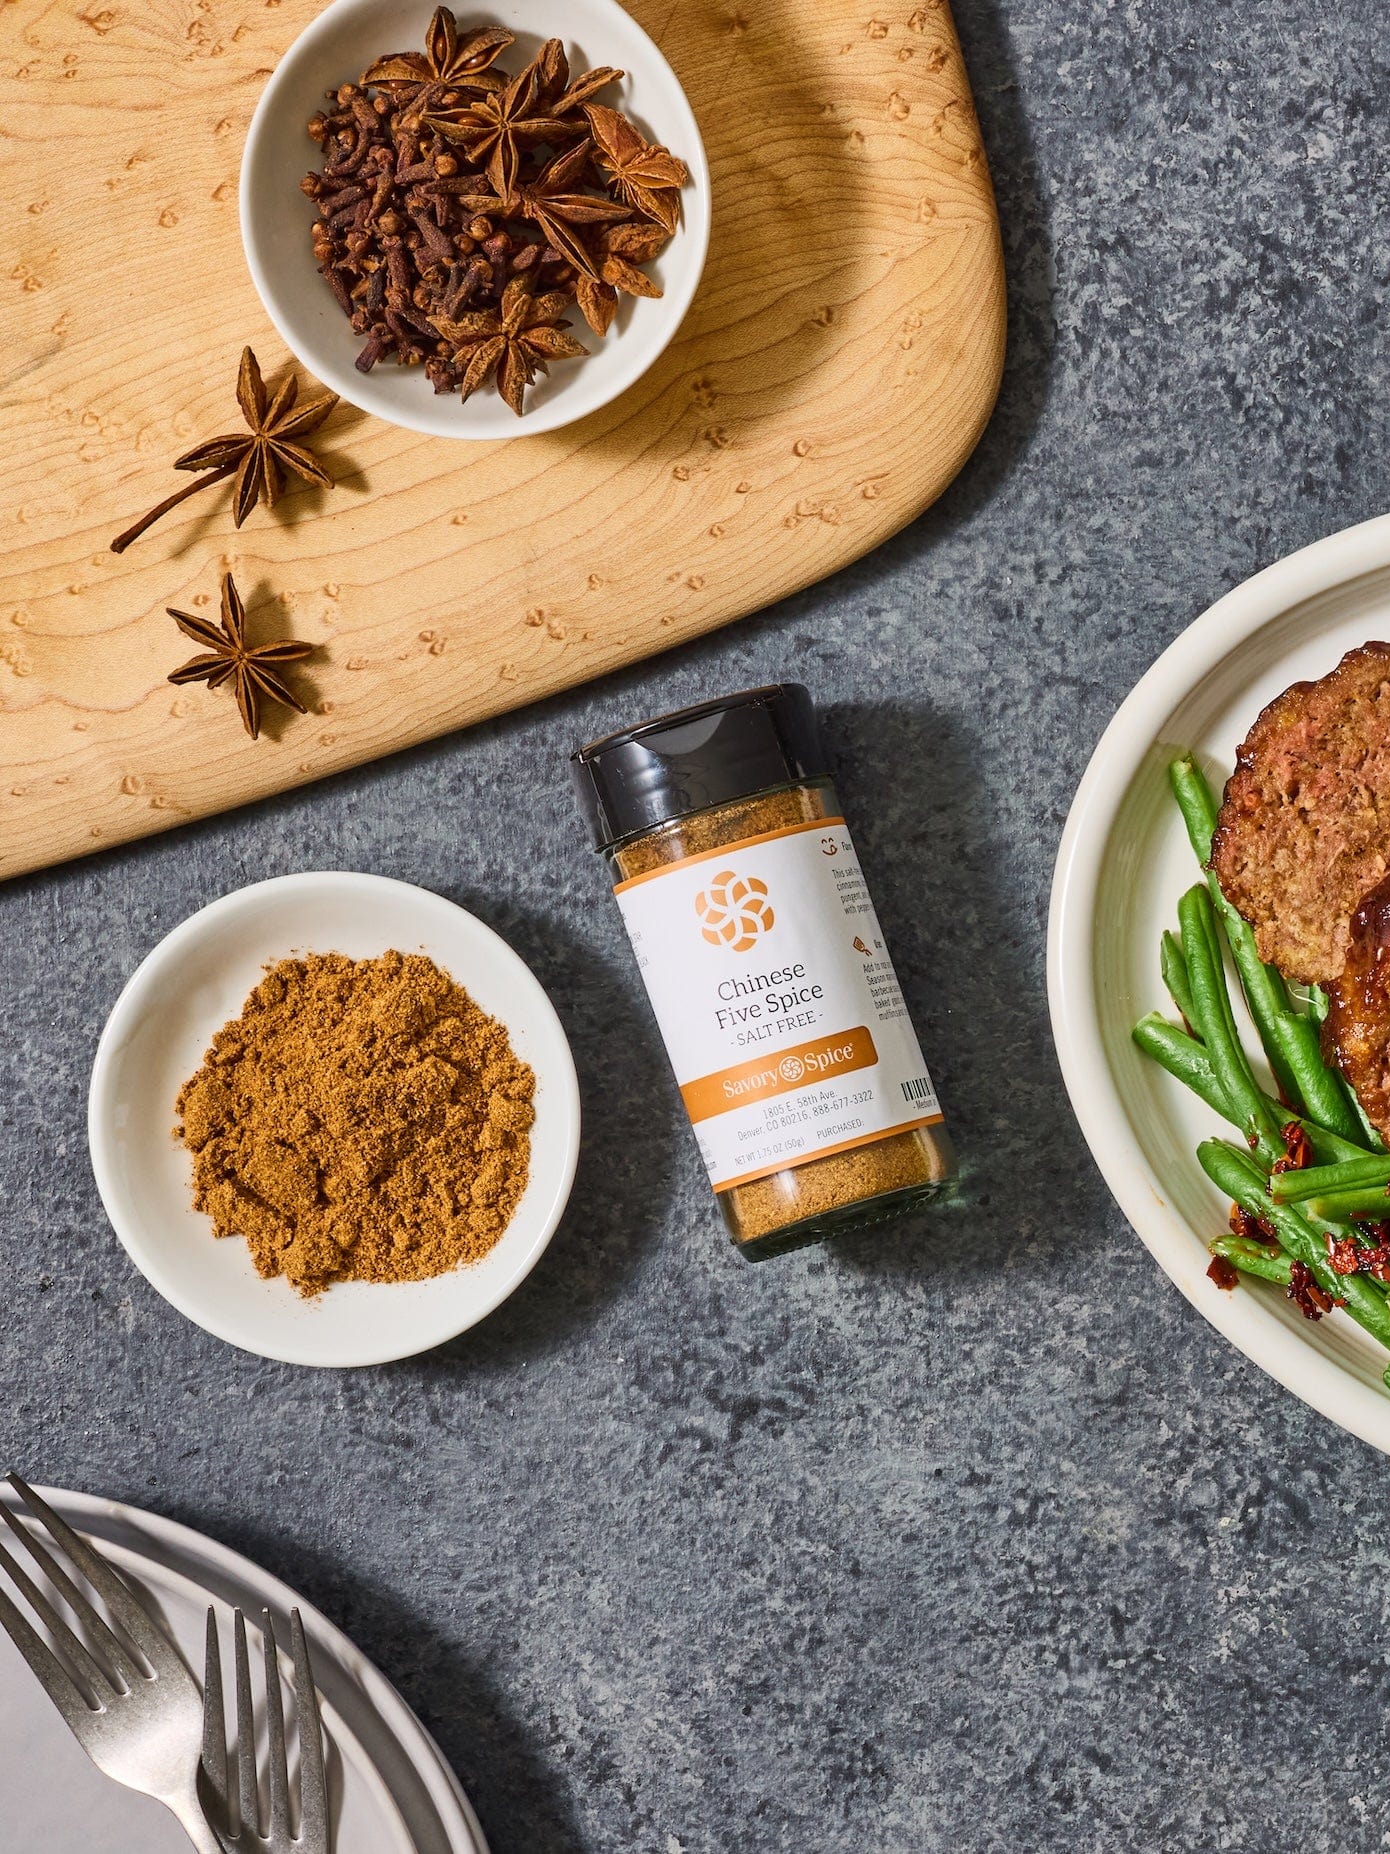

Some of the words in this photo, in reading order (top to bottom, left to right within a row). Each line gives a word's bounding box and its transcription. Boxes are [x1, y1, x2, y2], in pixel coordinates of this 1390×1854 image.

[718, 964, 806, 1001] Chinese
[715, 1003, 762, 1030] Five
[766, 985, 824, 1014] Spice
[736, 1023, 773, 1046] SALT
[776, 1010, 817, 1033] FREE
[722, 1067, 779, 1098] Savory
[804, 1045, 854, 1071] Spice
[762, 1103, 785, 1120] 1805
[786, 1101, 796, 1112] E.
[797, 1094, 818, 1108] 58th
[820, 1090, 838, 1101] Ave.
[766, 1119, 779, 1132] CO
[813, 1089, 874, 1117] 888-677-3322
[817, 1118, 865, 1139] PURCHASED:
[734, 1154, 746, 1167] NET
[746, 1151, 756, 1162] WT
[757, 1146, 772, 1160] 1.75
[773, 1142, 783, 1154] OZ
[784, 1136, 806, 1152] (50g)
